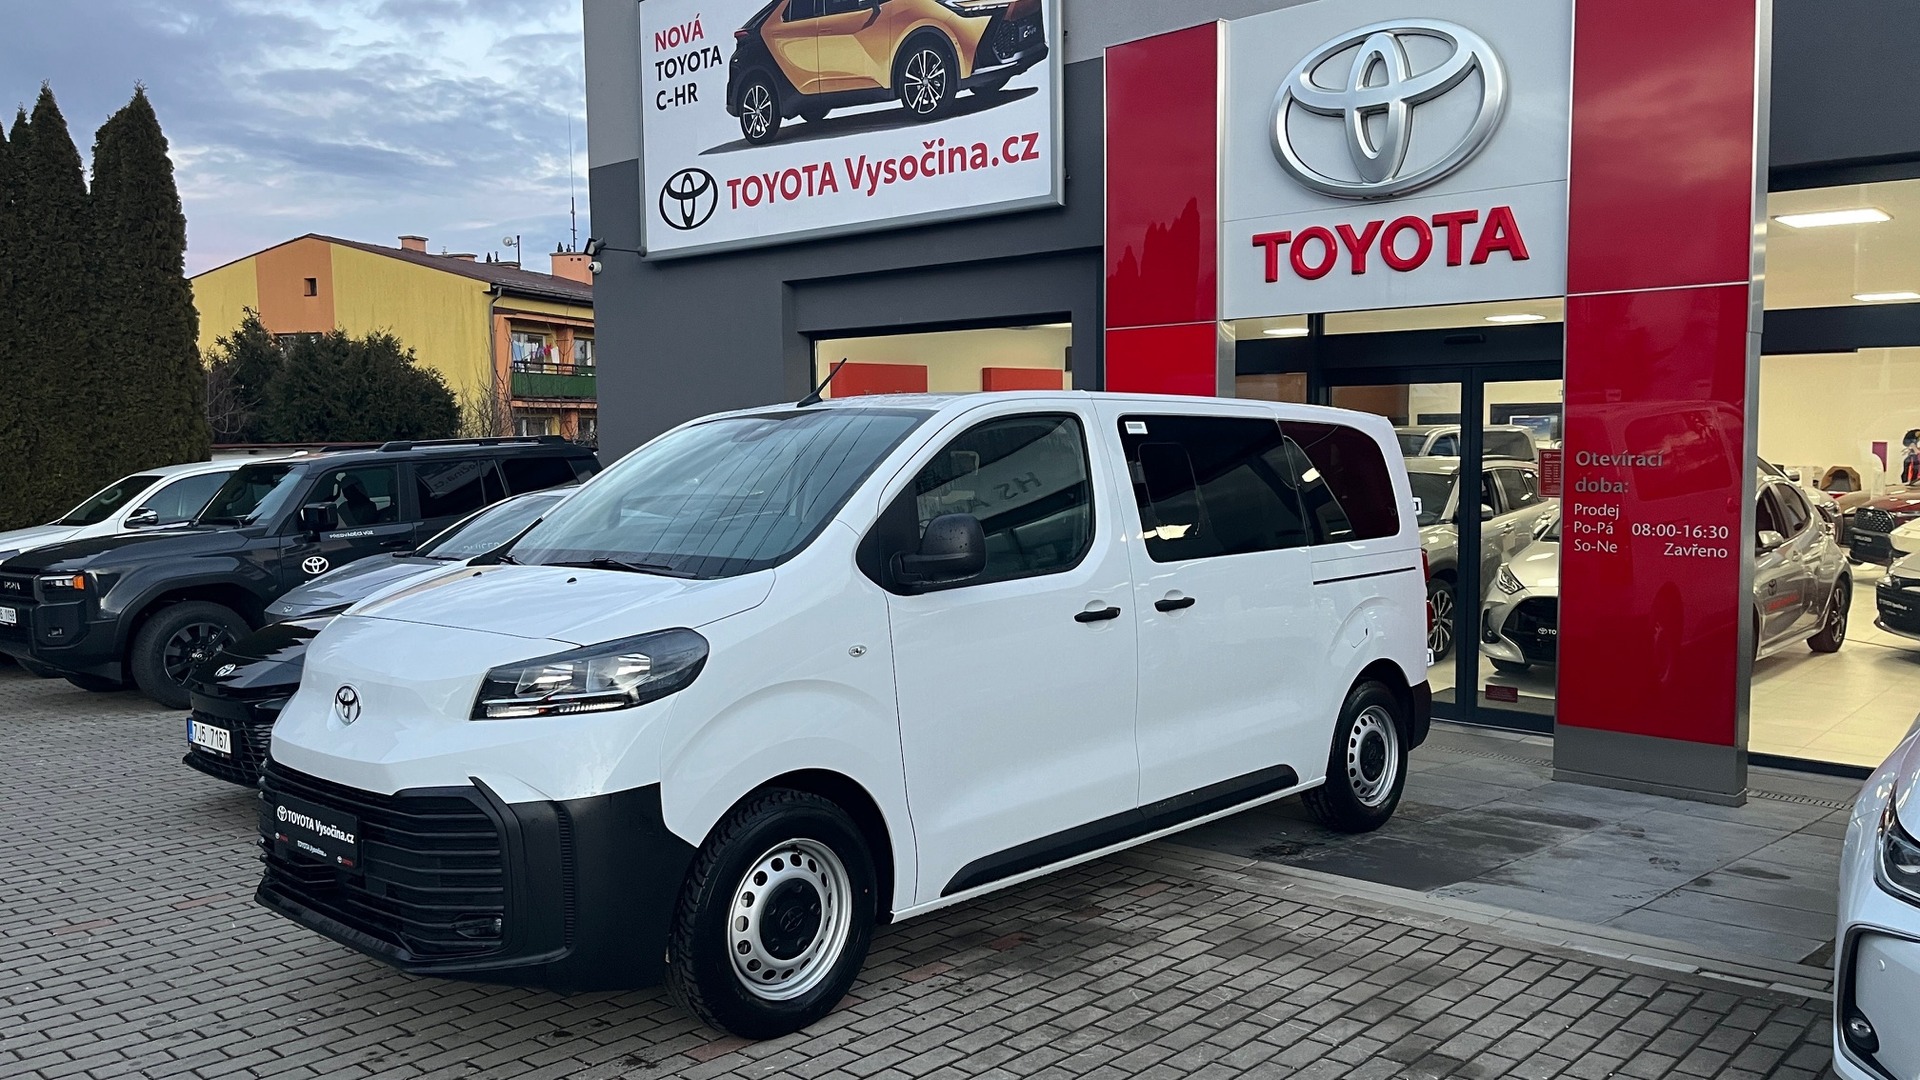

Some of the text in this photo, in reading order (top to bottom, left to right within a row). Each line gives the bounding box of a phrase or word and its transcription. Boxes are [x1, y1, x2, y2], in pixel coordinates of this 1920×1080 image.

[654, 14, 704, 52] NOVÁ
[655, 45, 723, 82] TOYOTA
[656, 83, 699, 111] C-HR
[727, 131, 1040, 210] TOYOTA Vysočina.cz
[1252, 206, 1530, 283] TOYOTA
[1575, 450, 1663, 467] Otevírací
[1575, 477, 1629, 493] doba:
[1574, 503, 1619, 520] Prodej
[1574, 521, 1729, 539] Po-Pá 08:00-16:30
[1574, 539, 1728, 558] So-Ne Zavřeno
[211, 728, 228, 749] 7167
[287, 810, 354, 844] TOYOTA Vysočina.cz
